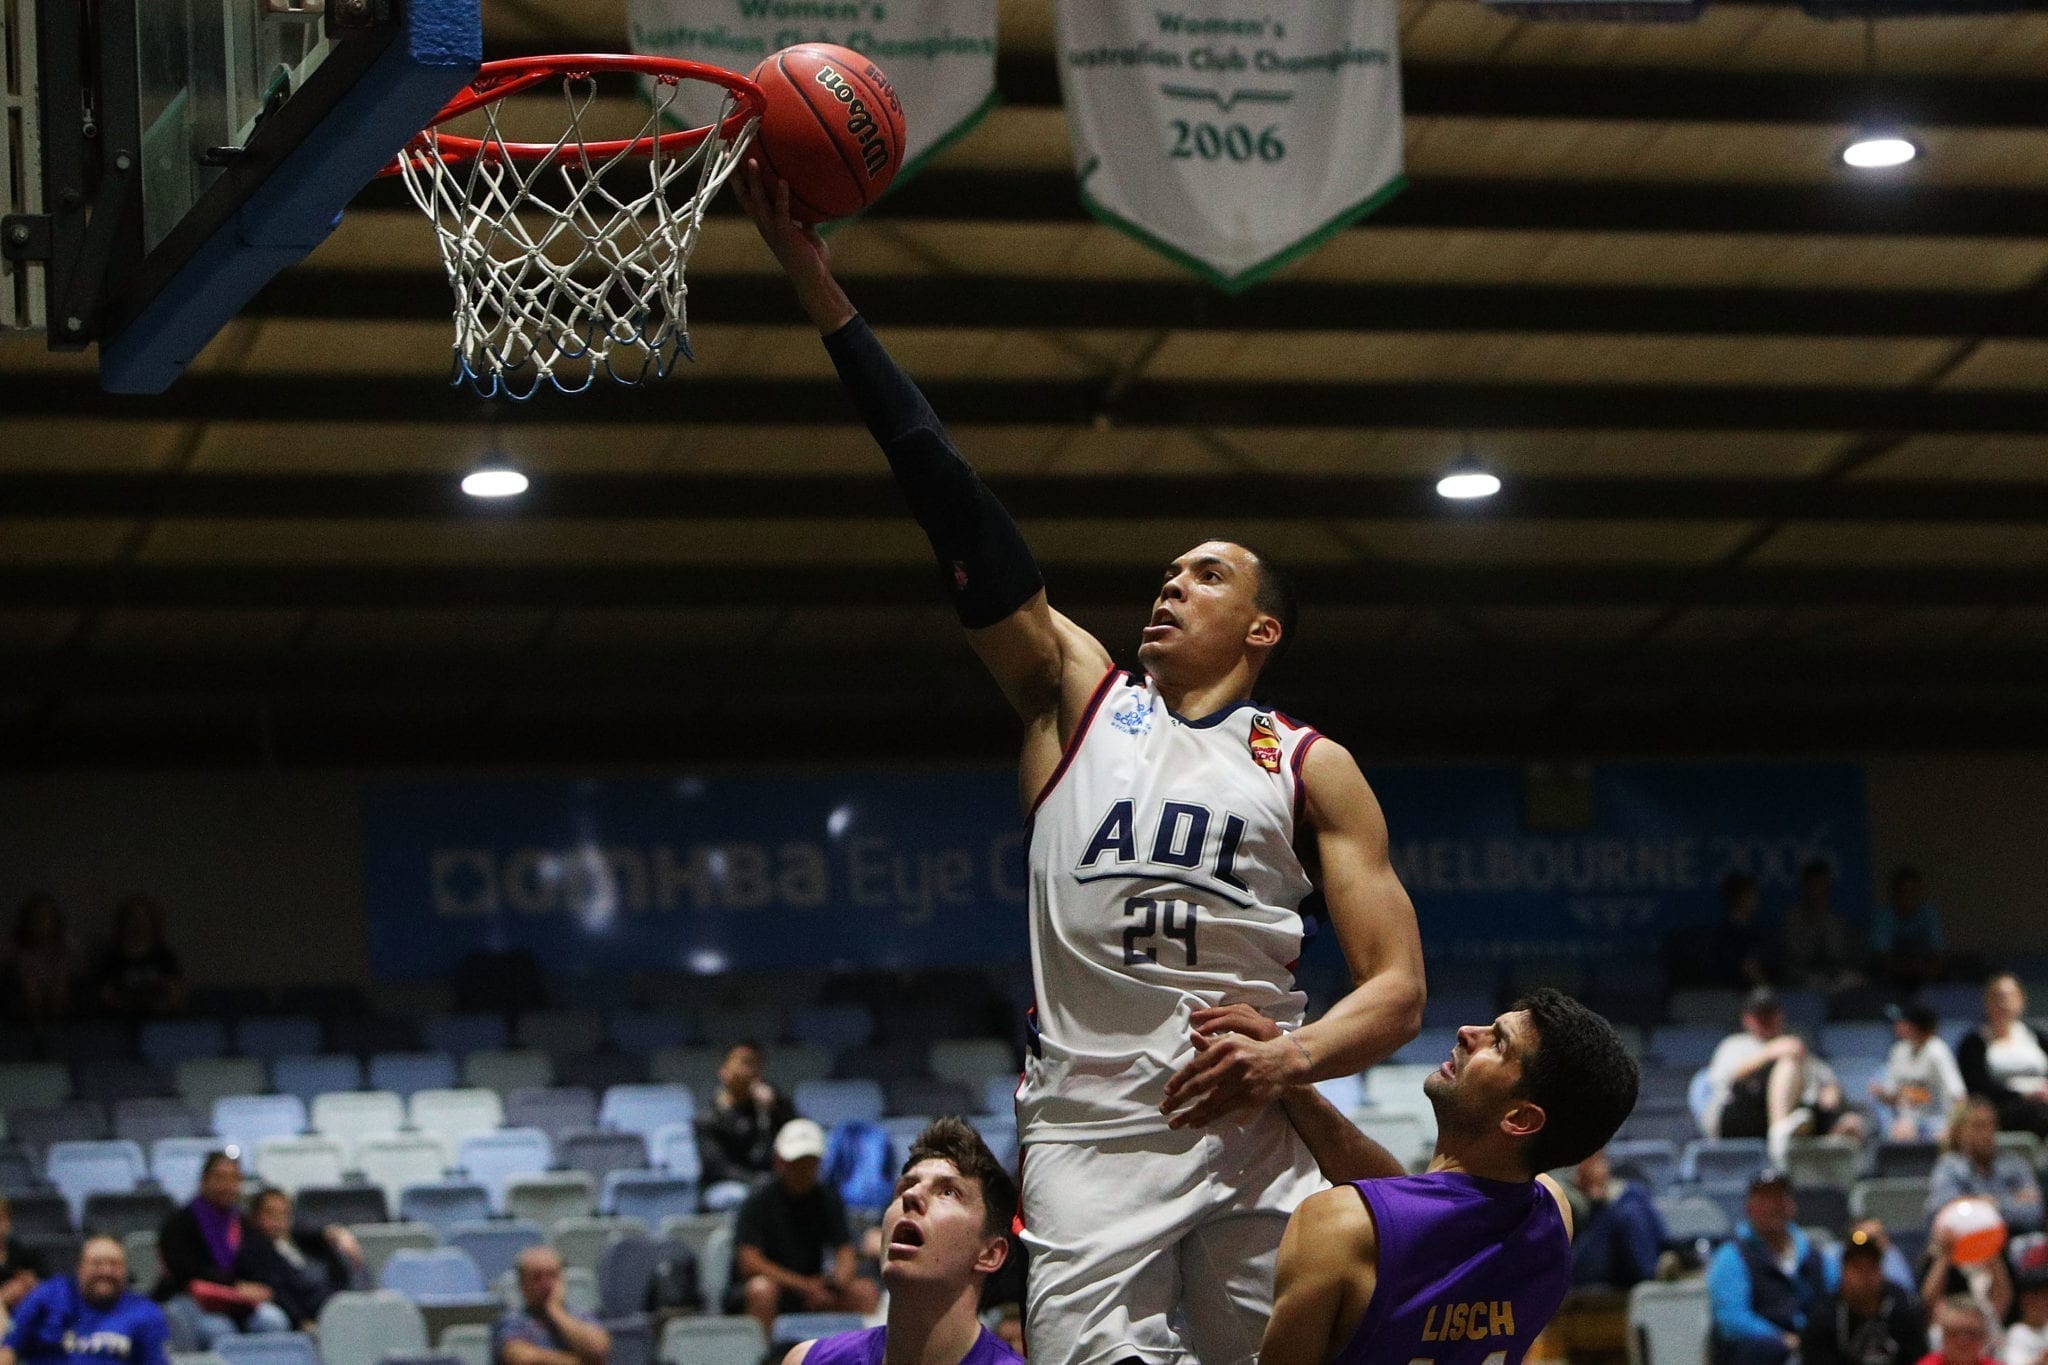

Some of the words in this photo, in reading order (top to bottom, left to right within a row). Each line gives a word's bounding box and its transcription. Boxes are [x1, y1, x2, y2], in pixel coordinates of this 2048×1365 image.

[1156, 11, 1285, 38] Women's
[815, 64, 890, 180] Wilson
[1169, 119, 1286, 164] 2006
[1074, 798, 1251, 896] ADL
[1390, 837, 1701, 892] MELBOURNE
[849, 836, 974, 926] Eye
[1122, 896, 1199, 967] 24
[1421, 1300, 1516, 1342] LISCH
